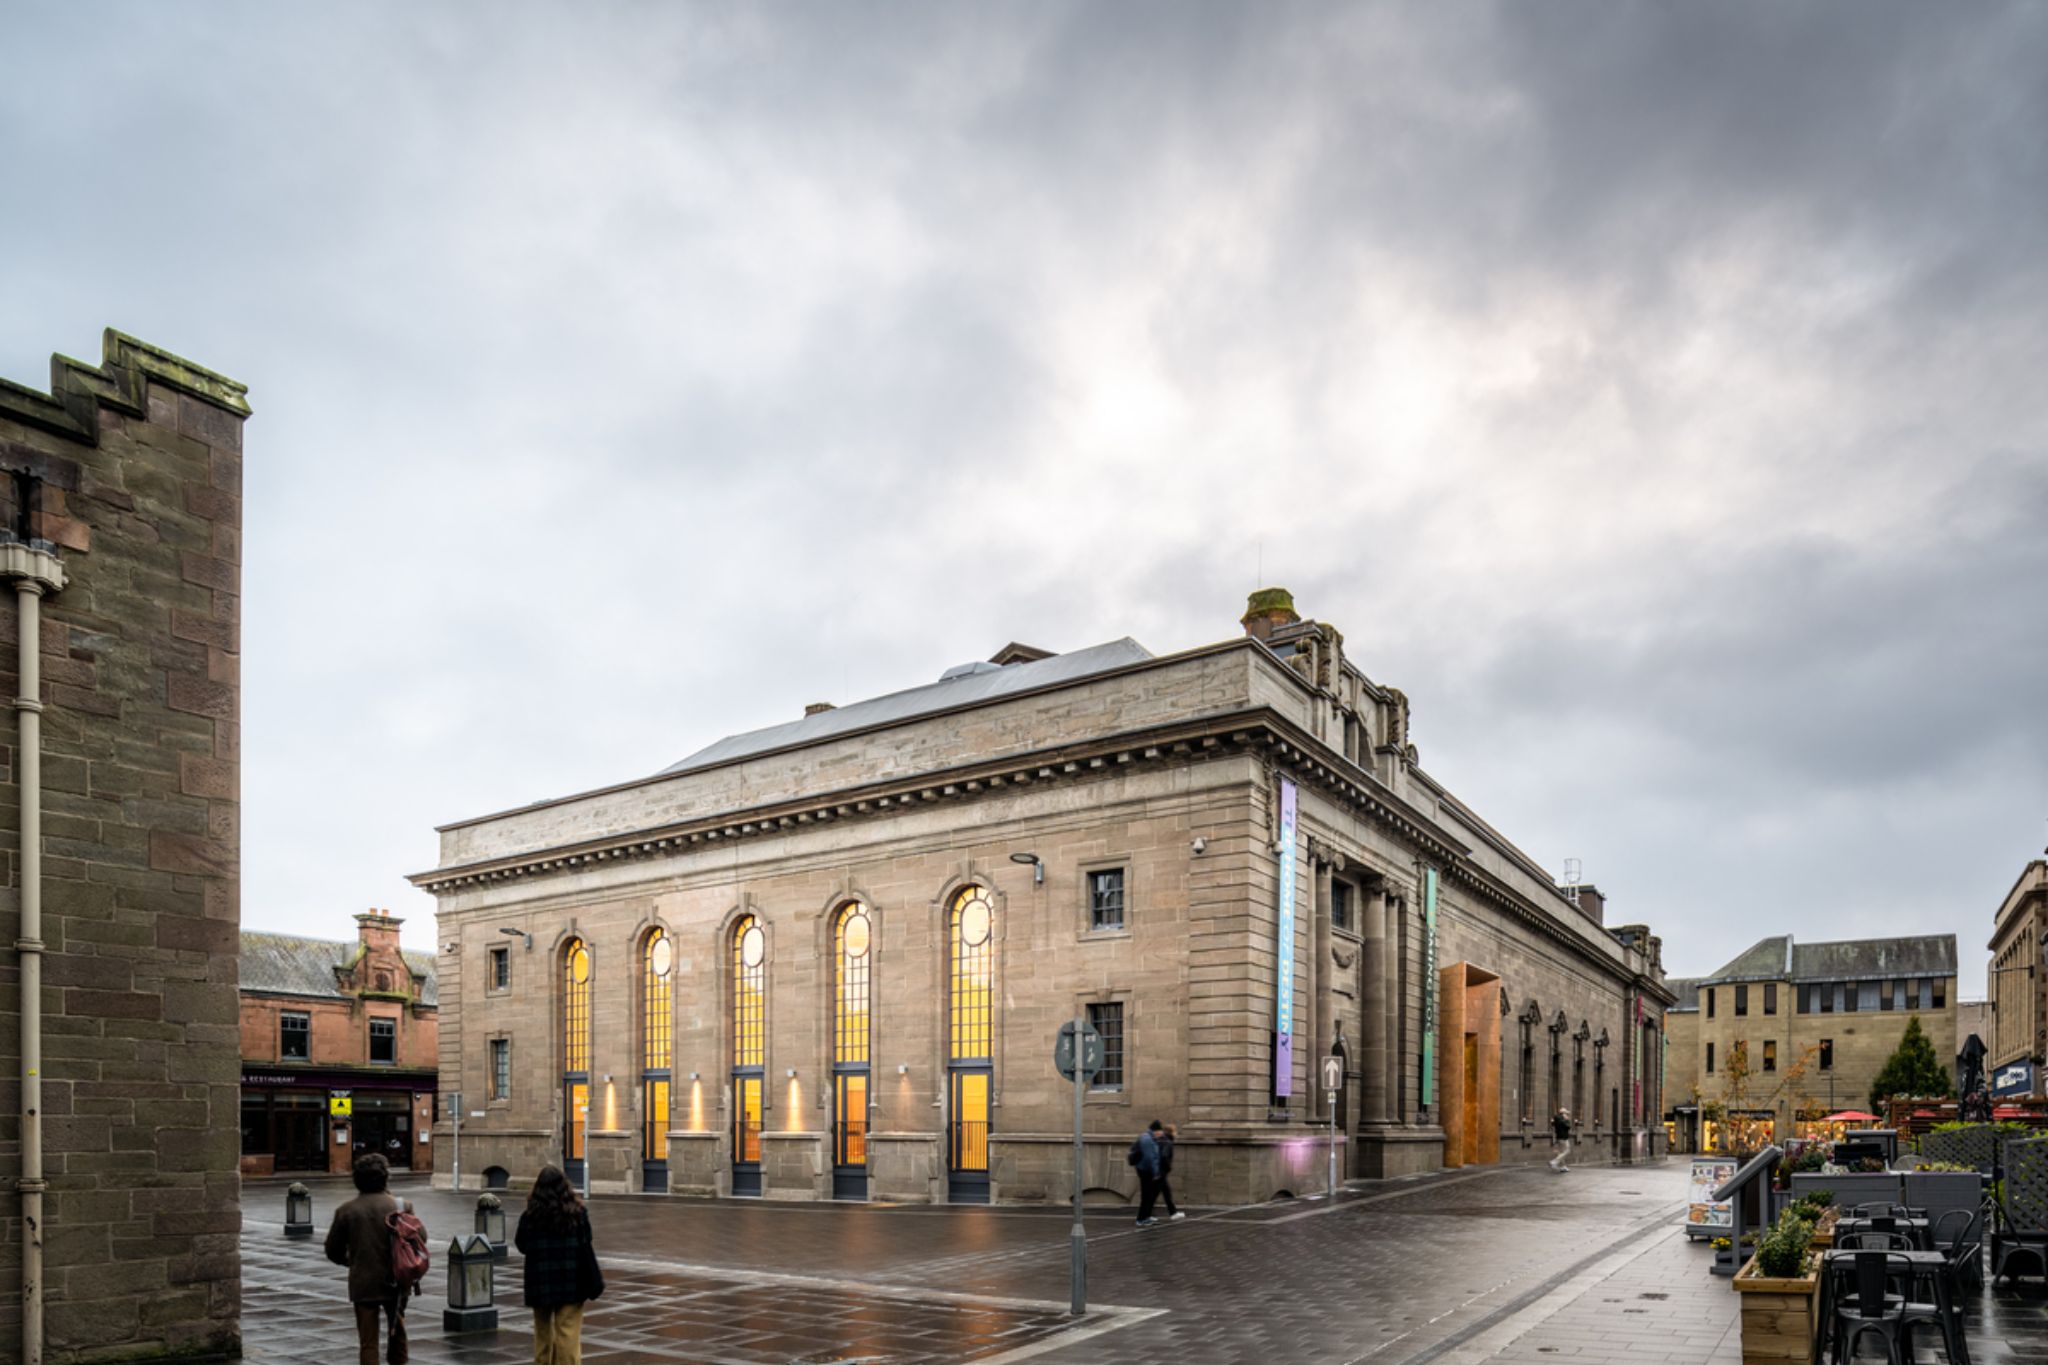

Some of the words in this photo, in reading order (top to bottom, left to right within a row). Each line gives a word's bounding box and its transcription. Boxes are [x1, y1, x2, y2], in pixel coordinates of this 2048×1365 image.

[1282, 854, 1292, 922] HOME
[1282, 924, 1291, 953] OF
[1280, 959, 1290, 1053] DESTINY
[249, 1075, 296, 1083] RESTAURANT
